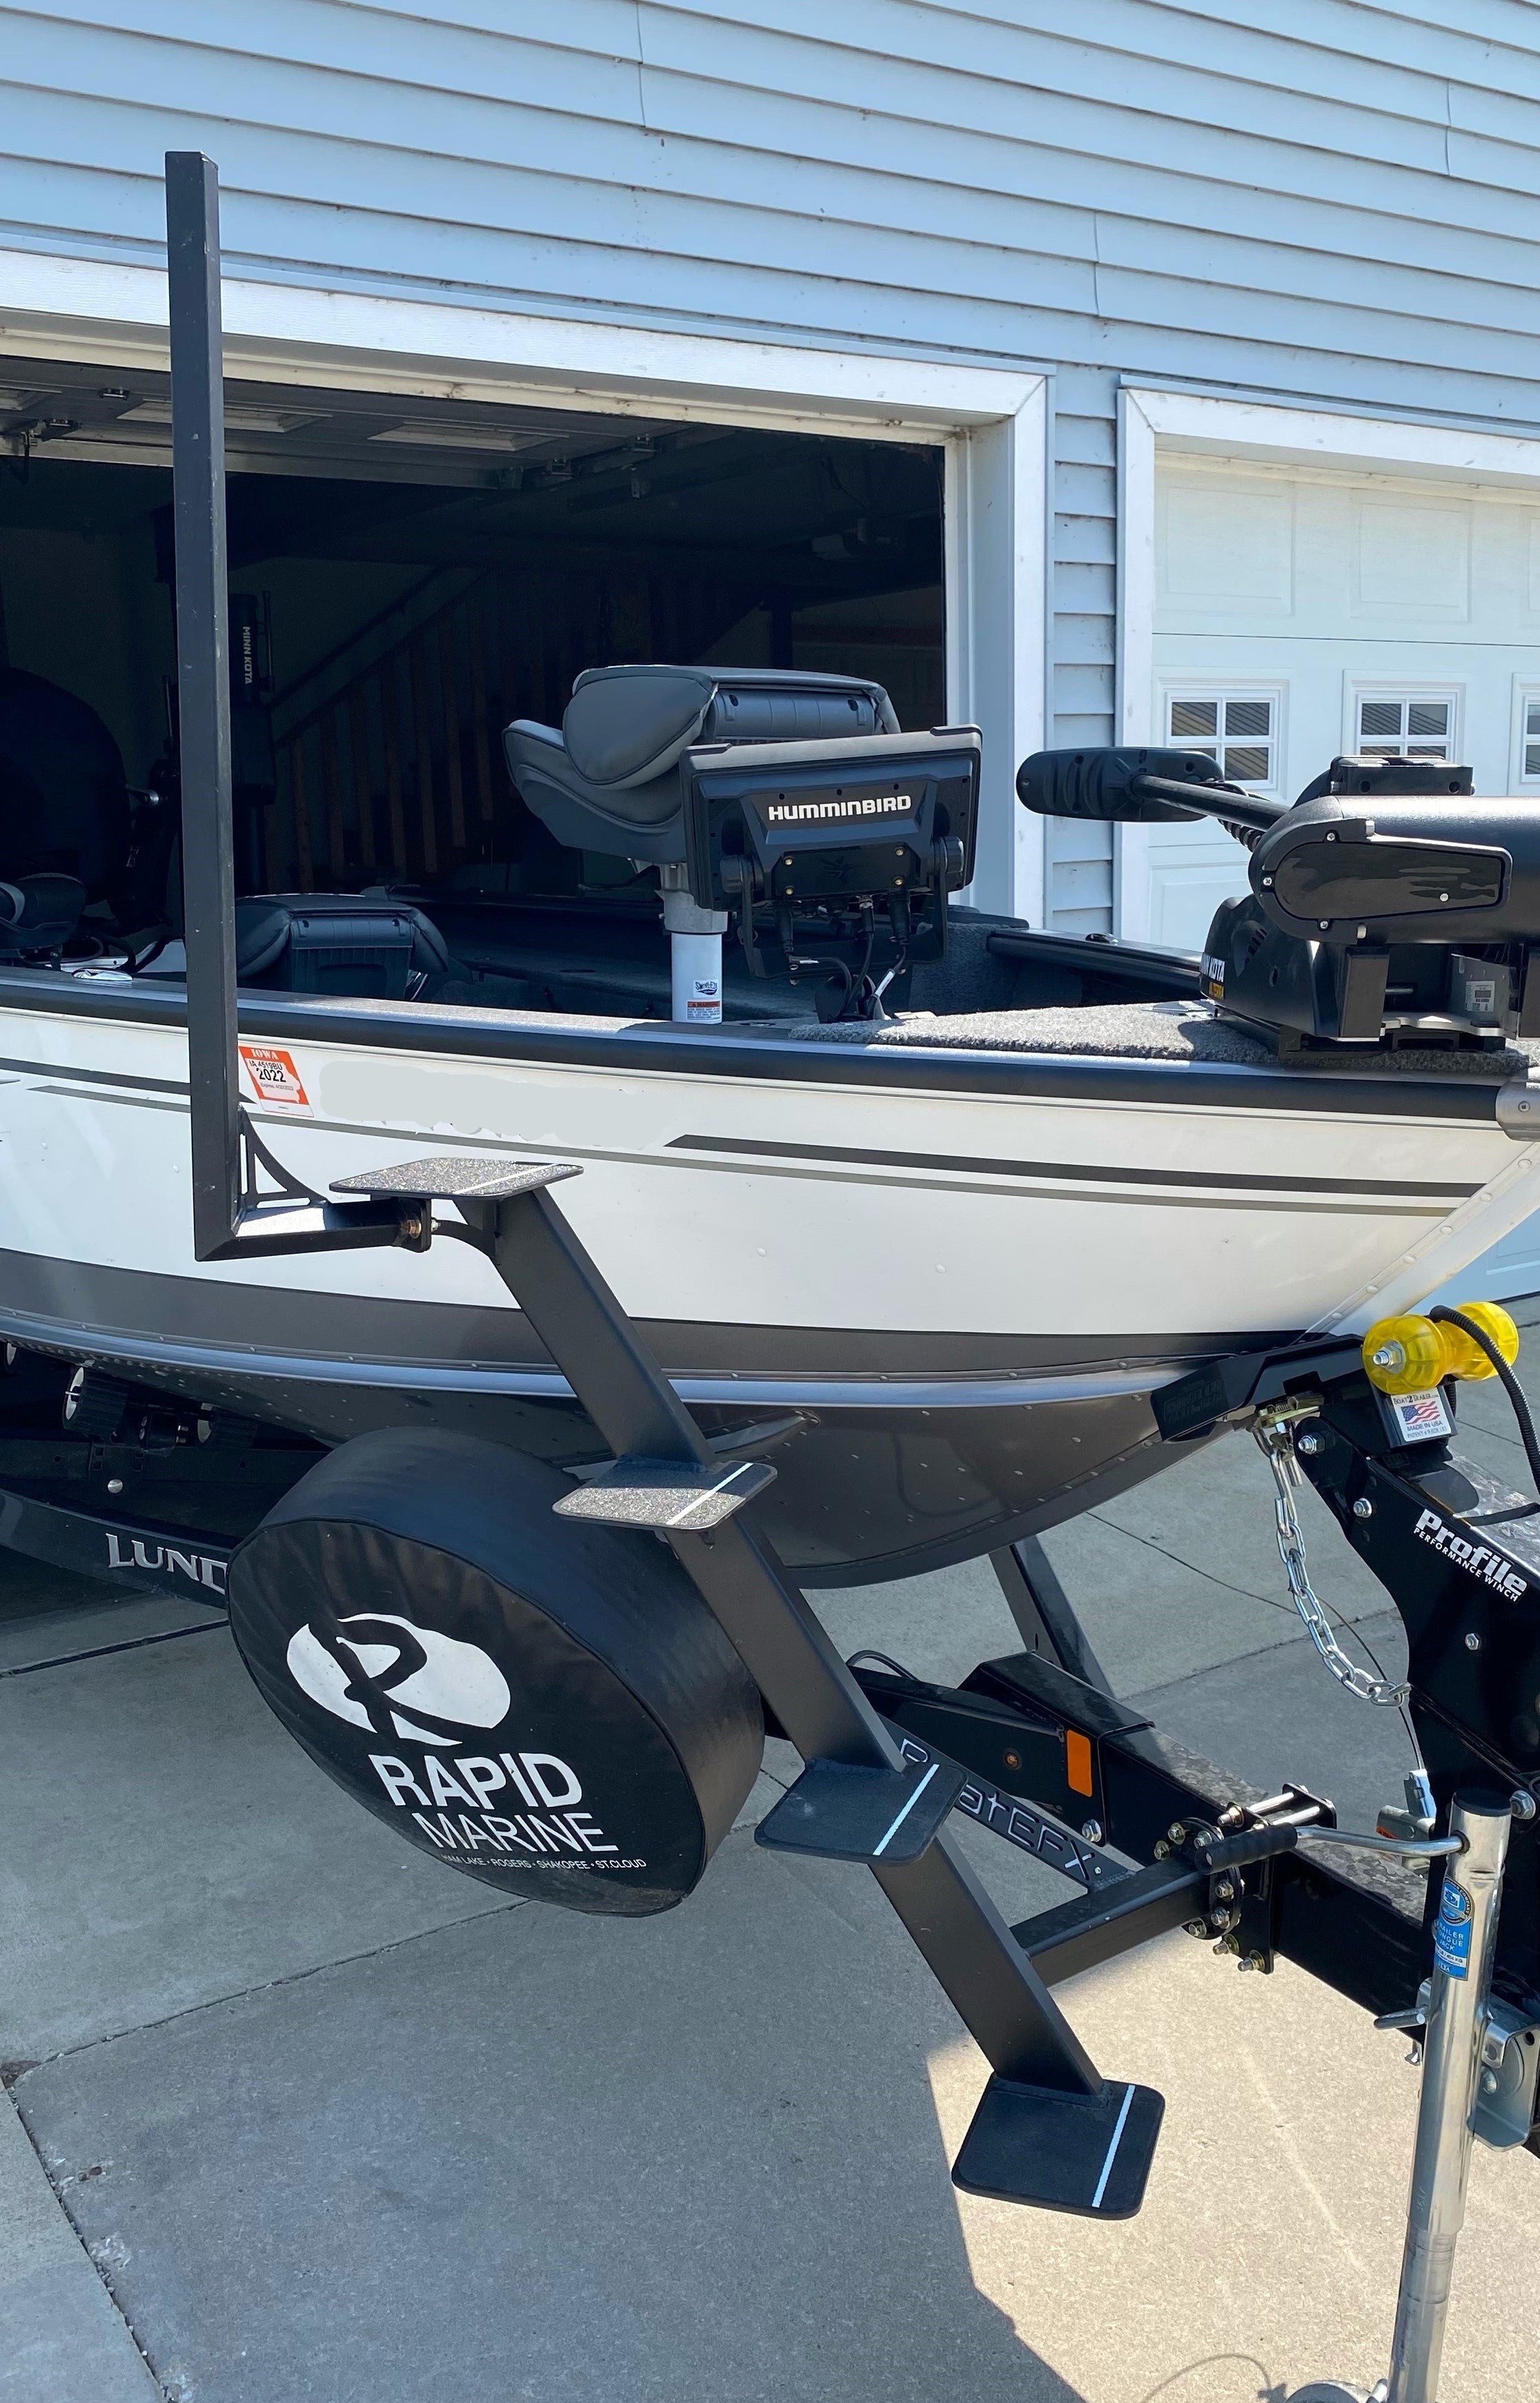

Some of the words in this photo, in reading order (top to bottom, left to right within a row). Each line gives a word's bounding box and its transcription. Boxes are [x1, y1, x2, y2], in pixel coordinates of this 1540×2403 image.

[243, 626, 252, 655] MINN
[244, 656, 253, 685] KOTA
[768, 795, 911, 821] HUMMINBIRD
[1208, 957, 1225, 983] KOTA
[250, 1048, 279, 1060] IOWA
[256, 1068, 286, 1083] 2022
[106, 1533, 228, 1595] LUND
[1414, 1527, 1483, 1578] PERFORMANCE
[1485, 1575, 1519, 1602] WINCH
[1416, 1509, 1527, 1596] Profile
[368, 1753, 582, 1809] RAPID
[411, 1812, 619, 1852] MARINE
[460, 1856, 487, 1865] LAKE
[490, 1858, 532, 1868] ROGERS
[536, 1860, 591, 1870] SHAKOPEE
[1439, 1939, 1454, 1951] JACK
